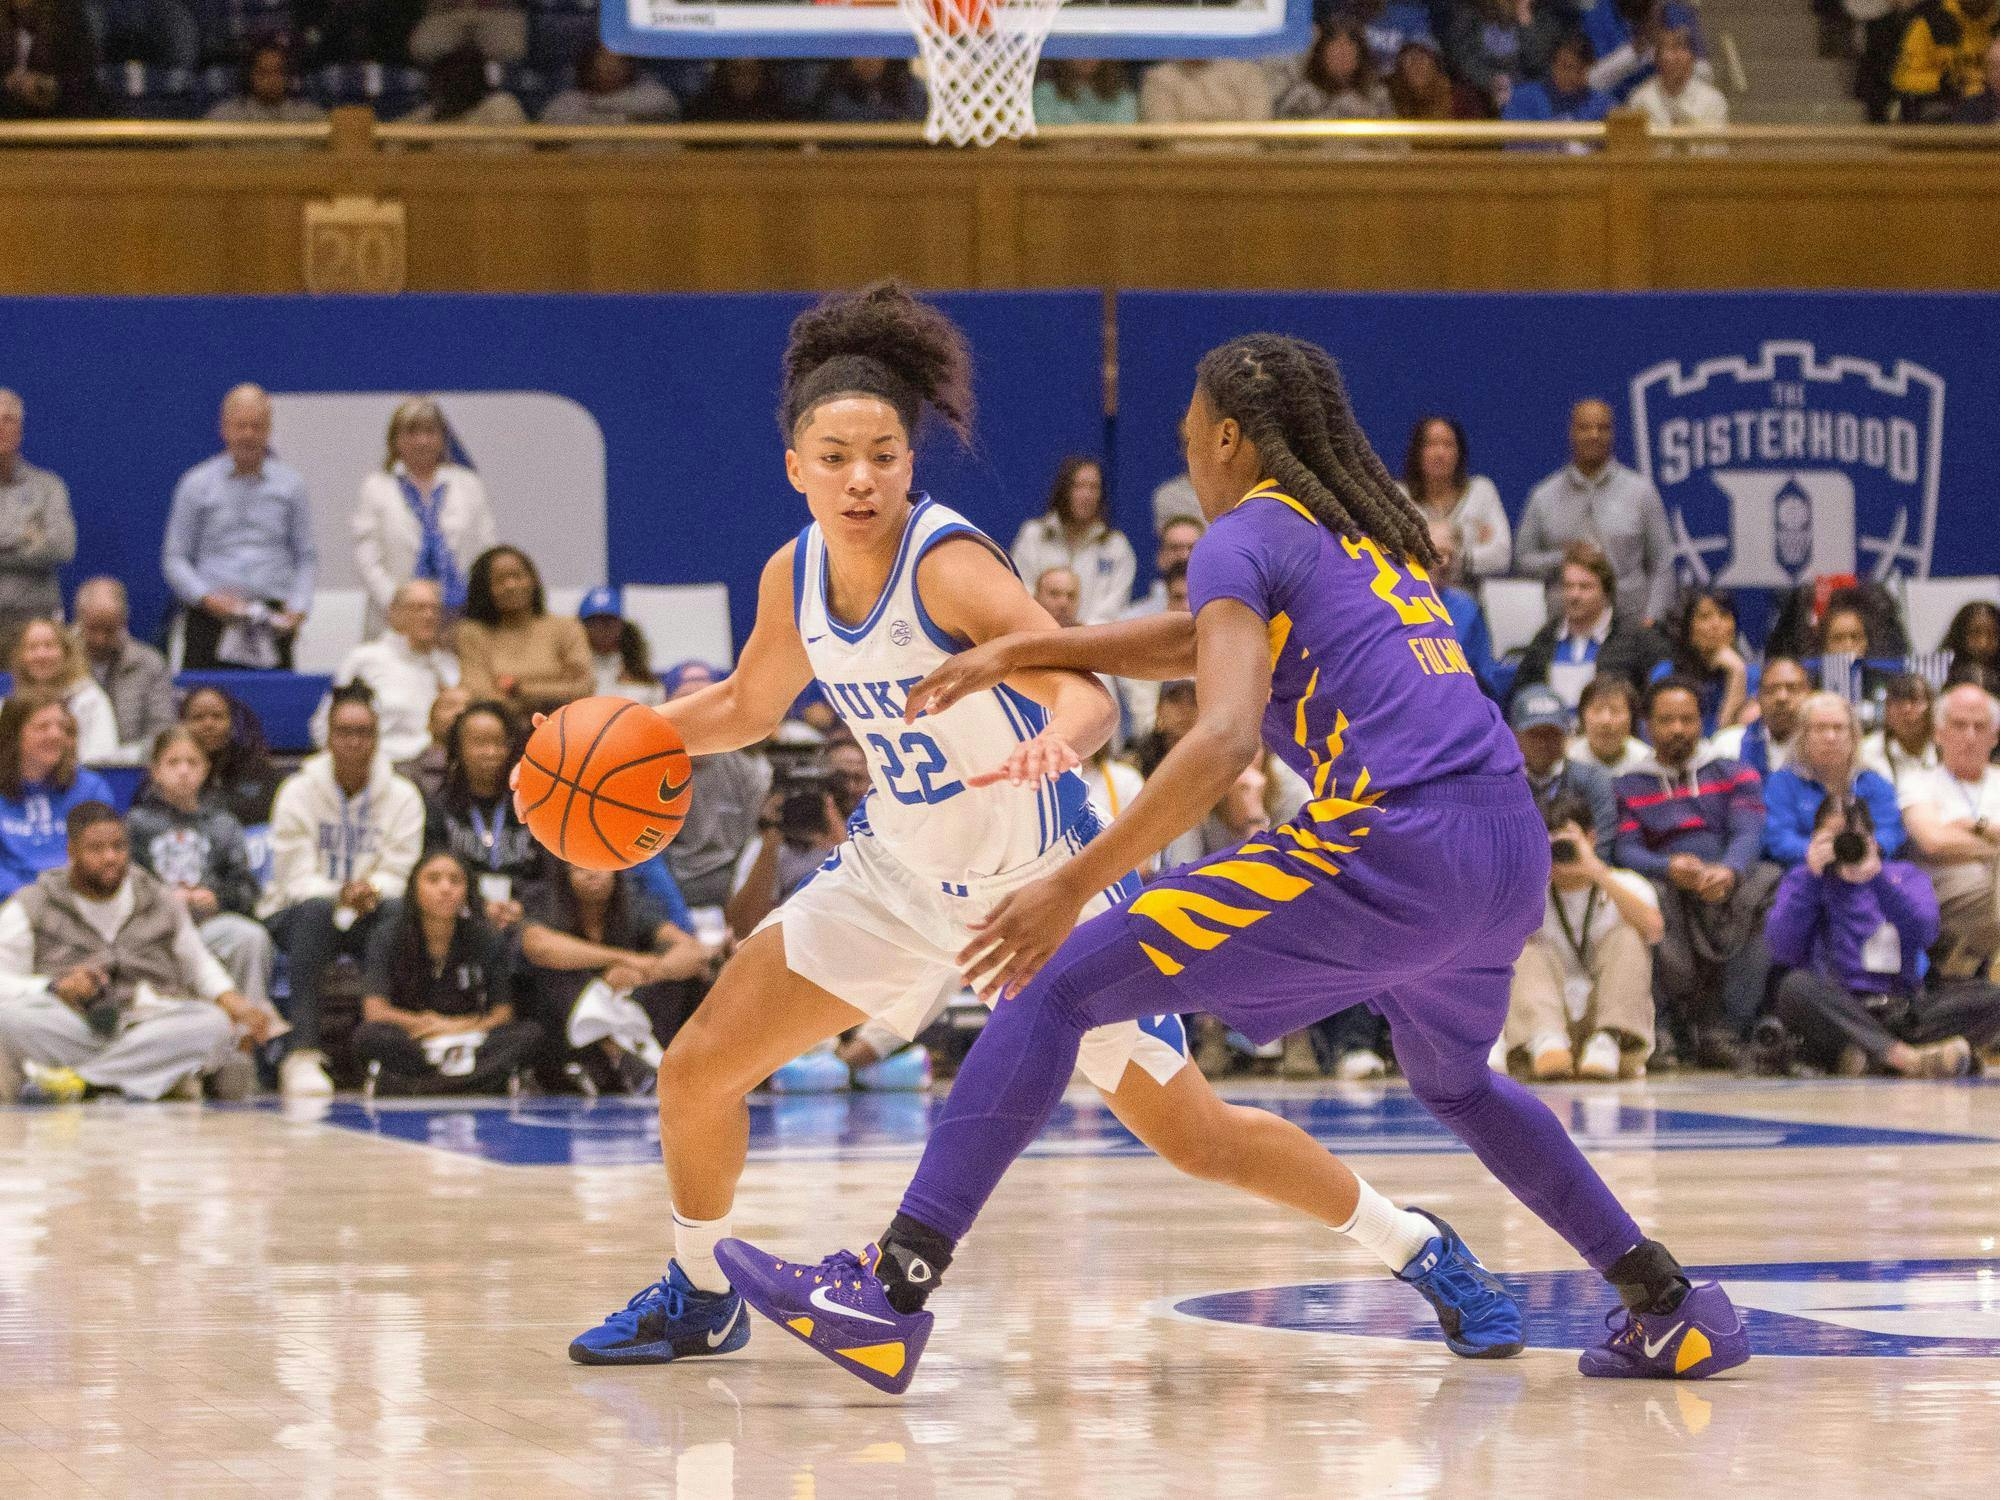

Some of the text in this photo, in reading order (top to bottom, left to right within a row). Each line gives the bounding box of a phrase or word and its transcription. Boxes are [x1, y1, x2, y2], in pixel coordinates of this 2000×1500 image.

[1772, 383, 1804, 403] THE
[1660, 408, 1918, 485] SISTERHOOD
[1408, 637, 1474, 676] FULW
[866, 732, 966, 805] 22
